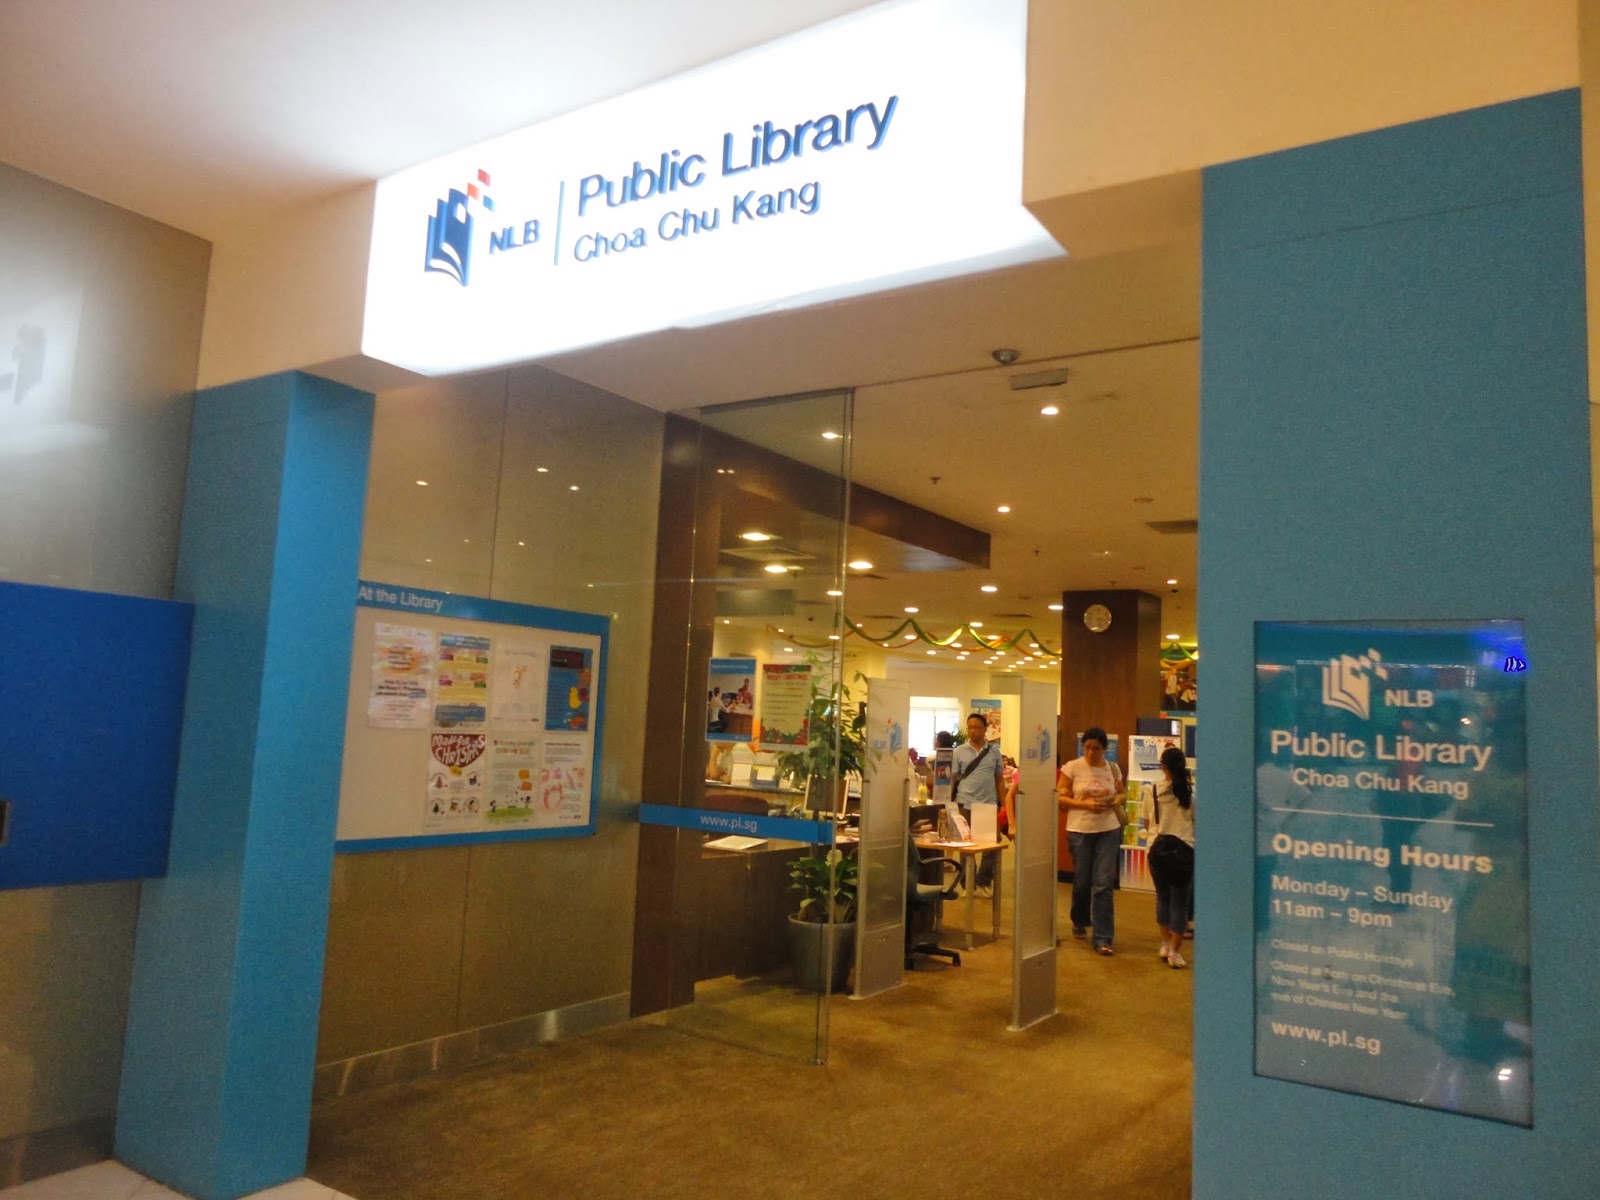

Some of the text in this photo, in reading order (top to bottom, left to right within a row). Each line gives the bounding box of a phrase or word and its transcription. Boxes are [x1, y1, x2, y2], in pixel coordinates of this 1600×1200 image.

[577, 95, 899, 217] Public Library
[488, 218, 540, 254] NLB
[573, 181, 821, 263] Choa Chu Kang
[357, 585, 444, 613] At the Library
[1384, 689, 1434, 708] NLB
[1270, 729, 1492, 772] Public Library
[1292, 767, 1469, 800] Choa Chu Kang
[700, 816, 757, 833] www.pl.sg
[1271, 833, 1493, 874] Opening Hours
[1271, 875, 1350, 902] Monday
[1374, 885, 1453, 913] Sunday
[1272, 899, 1324, 919] 11am
[1348, 907, 1393, 928] 9pm
[1271, 1021, 1381, 1055] www.pl.sg
